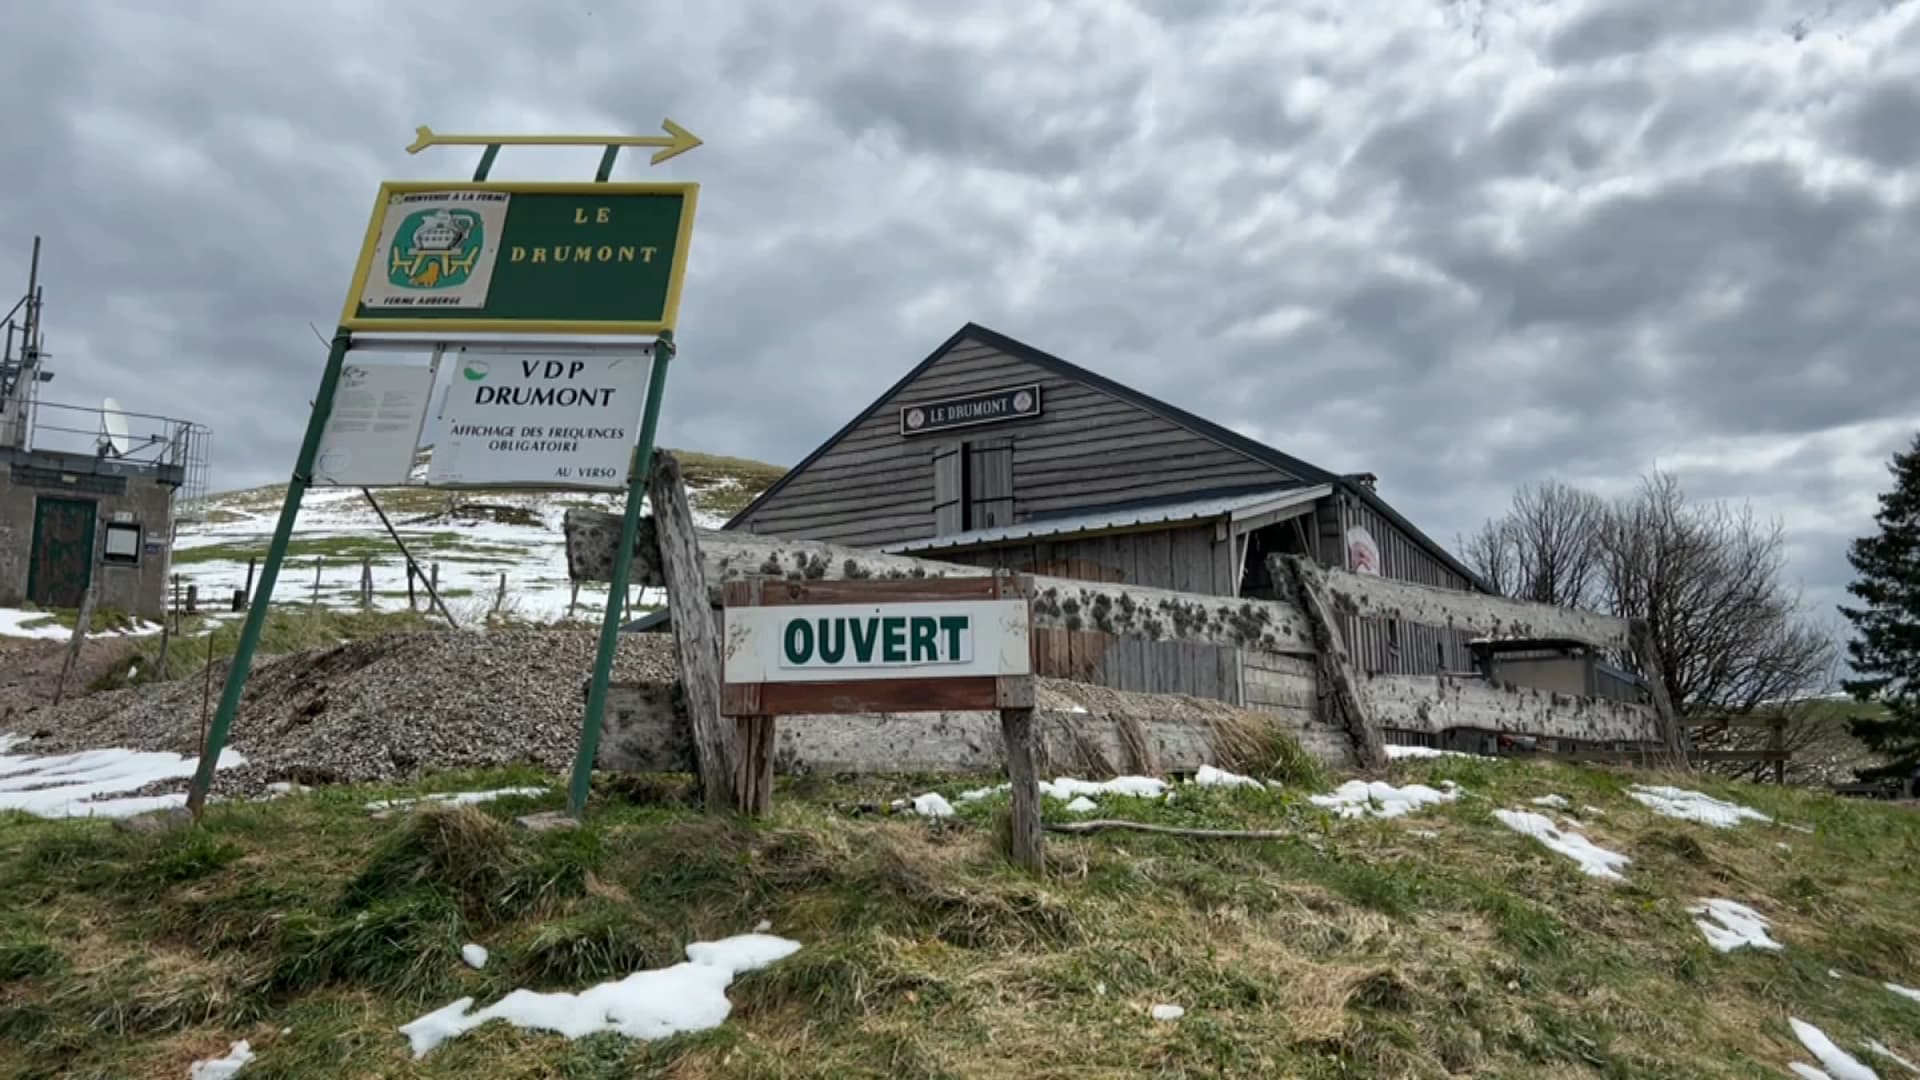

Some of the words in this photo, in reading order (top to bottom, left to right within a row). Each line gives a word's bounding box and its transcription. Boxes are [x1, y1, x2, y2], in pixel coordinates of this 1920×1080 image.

[574, 207, 612, 224] LE
[511, 246, 658, 263] DRUMONT
[521, 360, 585, 379] VDP
[474, 386, 616, 407] DRUMONT
[930, 408, 945, 423] LE
[948, 398, 1008, 420] DRUMONT
[451, 425, 515, 438] AFFICHAGE
[520, 427, 543, 438] DES
[548, 427, 625, 440] FREQUENCES
[488, 439, 578, 452] OBLIGATOIRE
[555, 466, 572, 478] AU
[578, 467, 617, 478] VERSO
[783, 616, 969, 665] OUVERT
